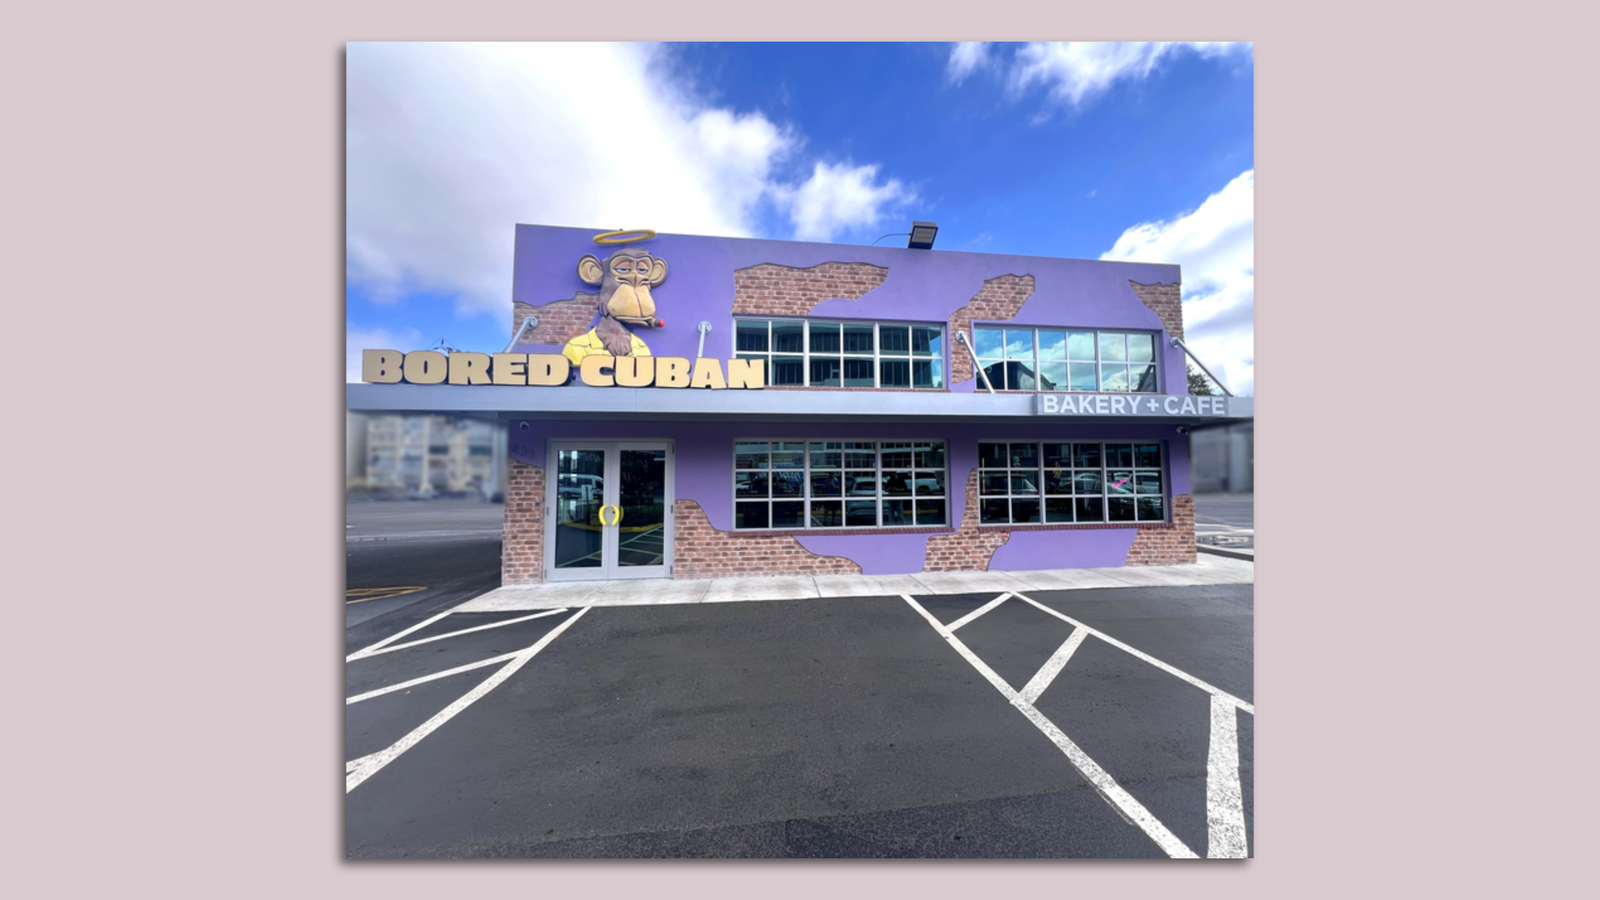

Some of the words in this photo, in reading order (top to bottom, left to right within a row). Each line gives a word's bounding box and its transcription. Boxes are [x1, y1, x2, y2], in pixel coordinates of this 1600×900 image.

[362, 349, 570, 387] BORED
[580, 354, 765, 390] CUBAN
[1042, 394, 1142, 415] BAKERY
[1163, 395, 1226, 415] CAFE
